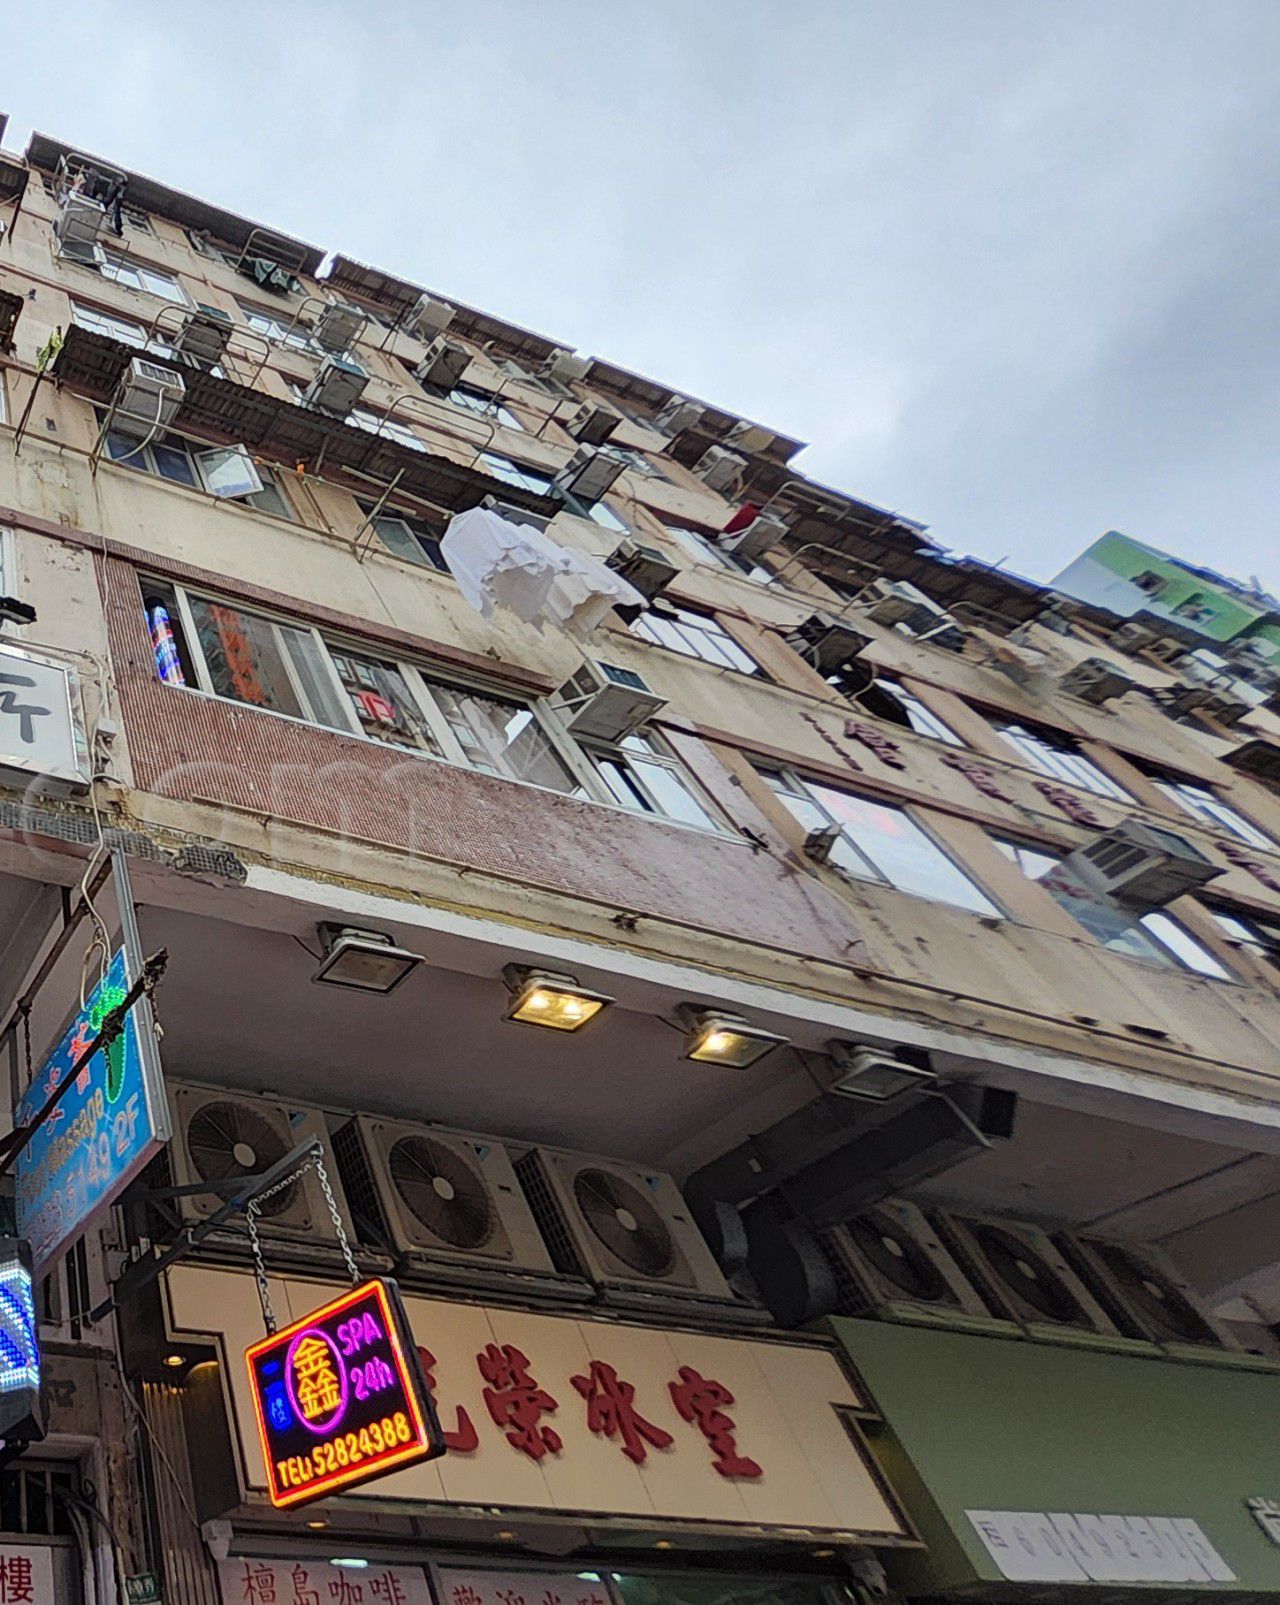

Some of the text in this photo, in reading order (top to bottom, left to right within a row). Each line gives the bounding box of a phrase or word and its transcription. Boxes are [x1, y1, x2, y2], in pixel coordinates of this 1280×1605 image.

[337, 1312, 383, 1356] SPA
[293, 1336, 343, 1421] 鑫
[350, 1356, 395, 1401] 24h
